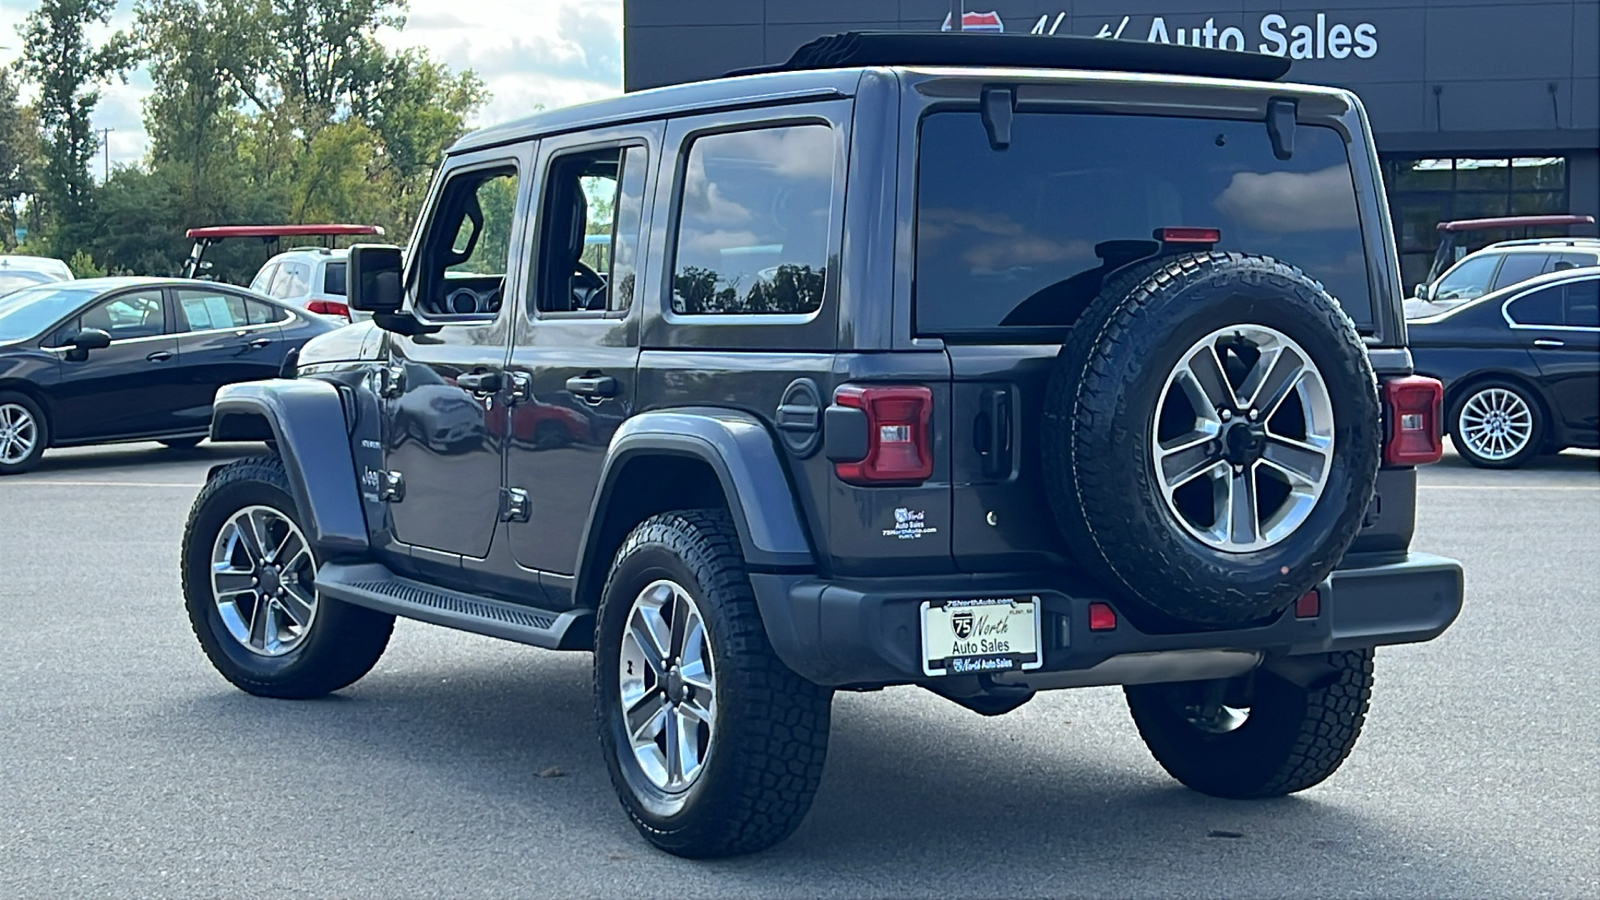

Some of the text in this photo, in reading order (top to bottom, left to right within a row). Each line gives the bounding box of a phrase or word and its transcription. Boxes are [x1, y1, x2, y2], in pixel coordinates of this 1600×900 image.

[1147, 17, 1244, 52] Auto
[1259, 13, 1378, 60] Sales
[955, 615, 1010, 637] 75 North
[952, 638, 1010, 655] Auto Sales
[981, 659, 995, 669] Auto
[996, 658, 1013, 668] Sales
